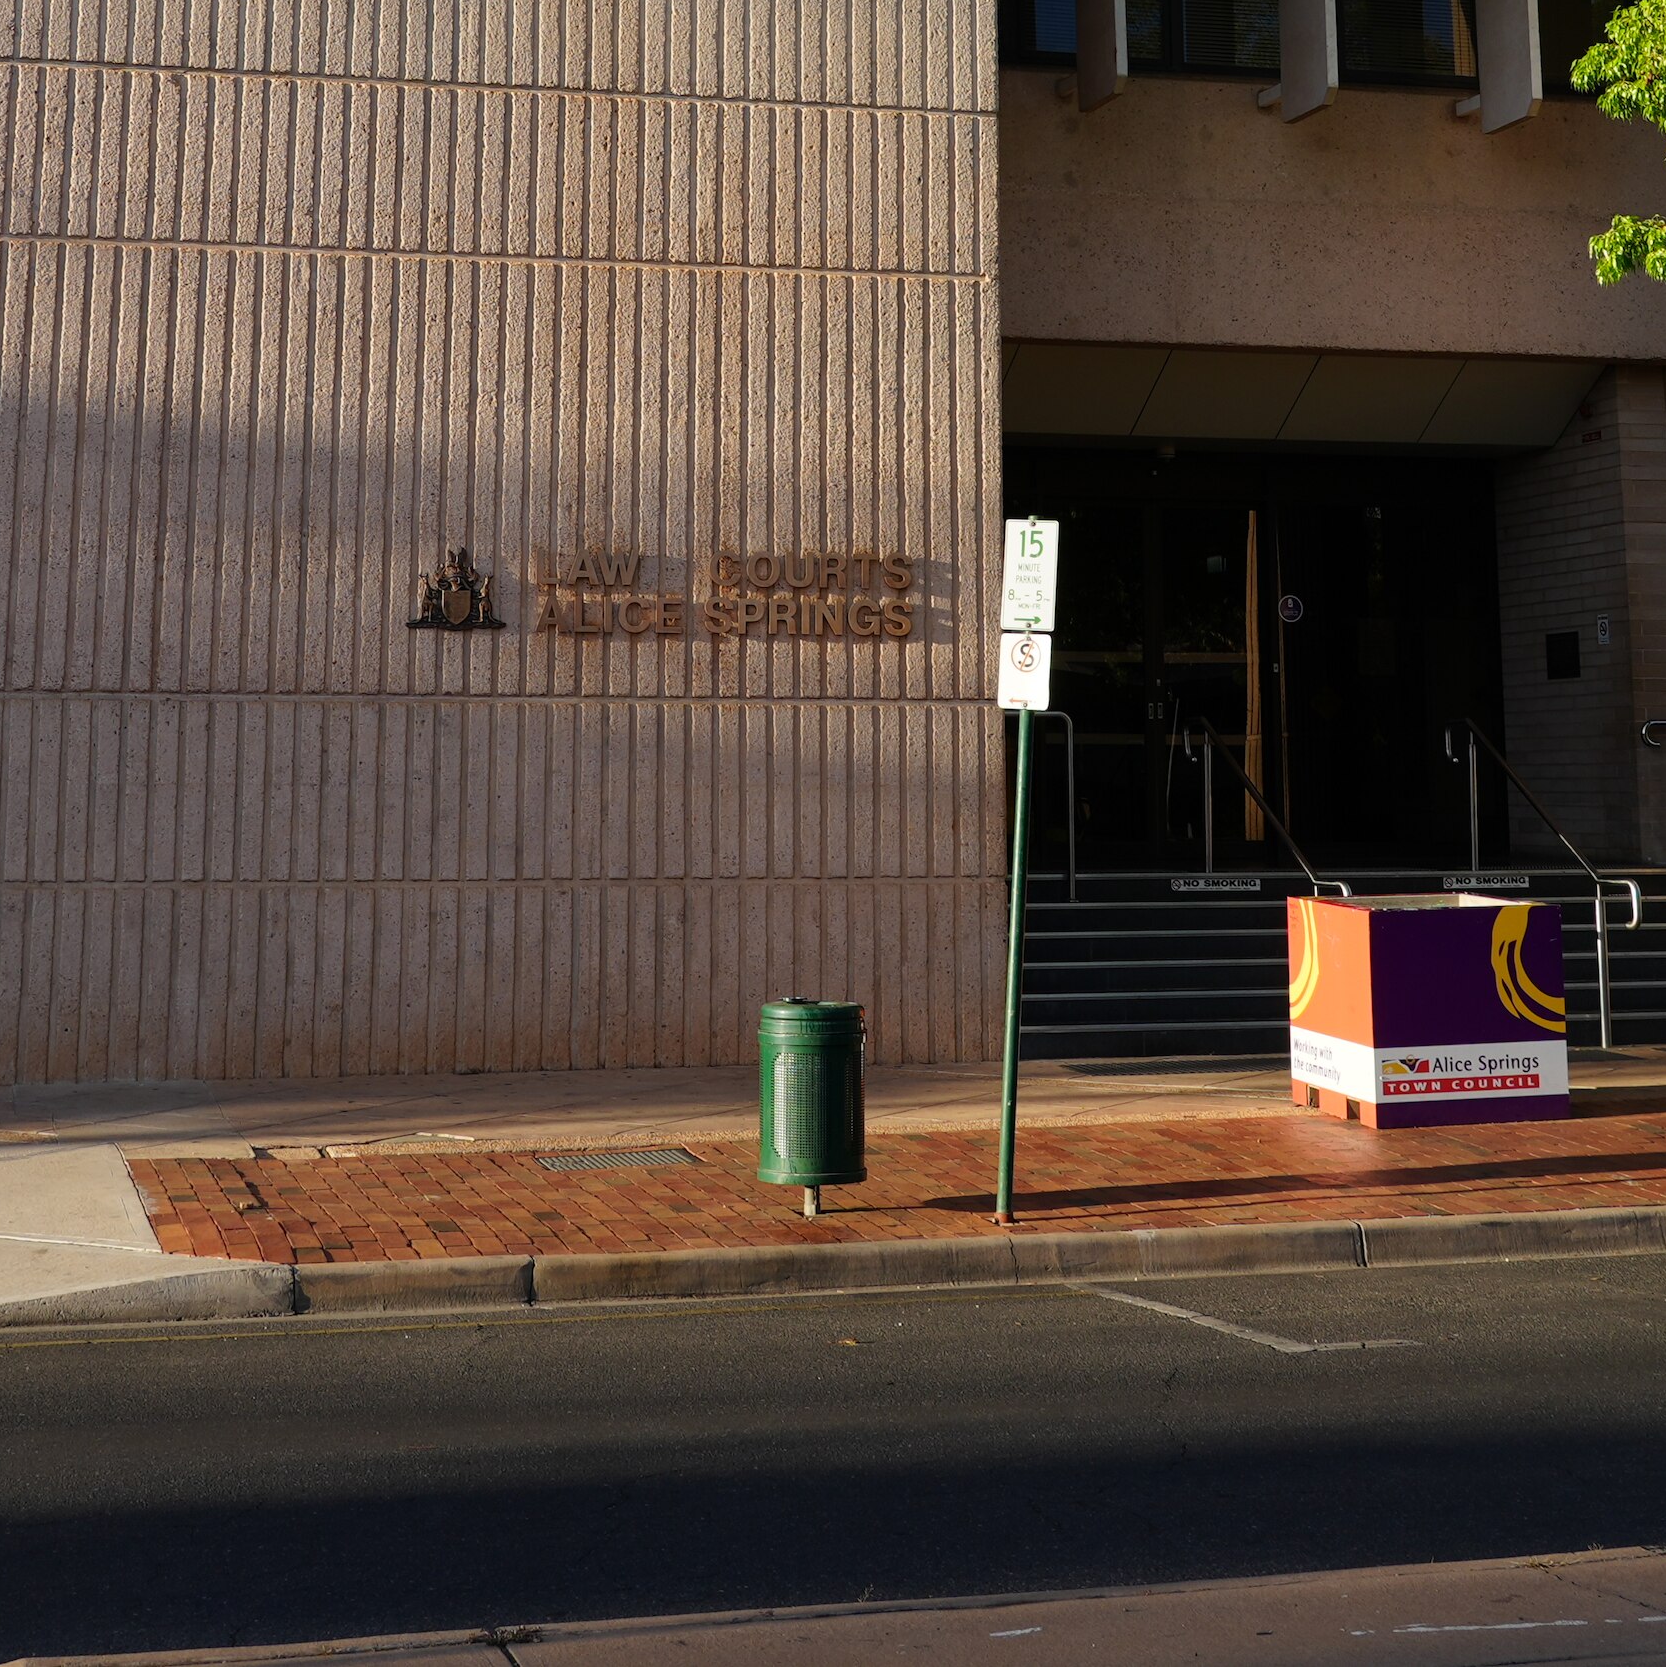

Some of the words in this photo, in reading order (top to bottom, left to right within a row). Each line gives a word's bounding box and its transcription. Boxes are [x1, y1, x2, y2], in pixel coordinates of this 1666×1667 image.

[1020, 530, 1044, 558] 15
[536, 548, 640, 586] LAW
[709, 550, 913, 589] COURTS
[1017, 563, 1041, 573] MINUTE
[1015, 574, 1042, 584] PARKING
[535, 595, 683, 634] ALICE
[703, 596, 913, 637] SPRINGS
[1183, 879, 1200, 887] NO
[1204, 879, 1257, 887] SMOKING
[1455, 877, 1472, 885] NO
[1476, 877, 1526, 885] SMOKING
[1293, 1038, 1318, 1060] Working
[1319, 1046, 1333, 1060] with
[1293, 1056, 1304, 1070] the
[1305, 1062, 1341, 1085] community
[1432, 1056, 1472, 1073] Alice
[1478, 1054, 1539, 1074] Springs
[1387, 1081, 1441, 1093] TOWN
[1451, 1077, 1535, 1090] COUNCIL
